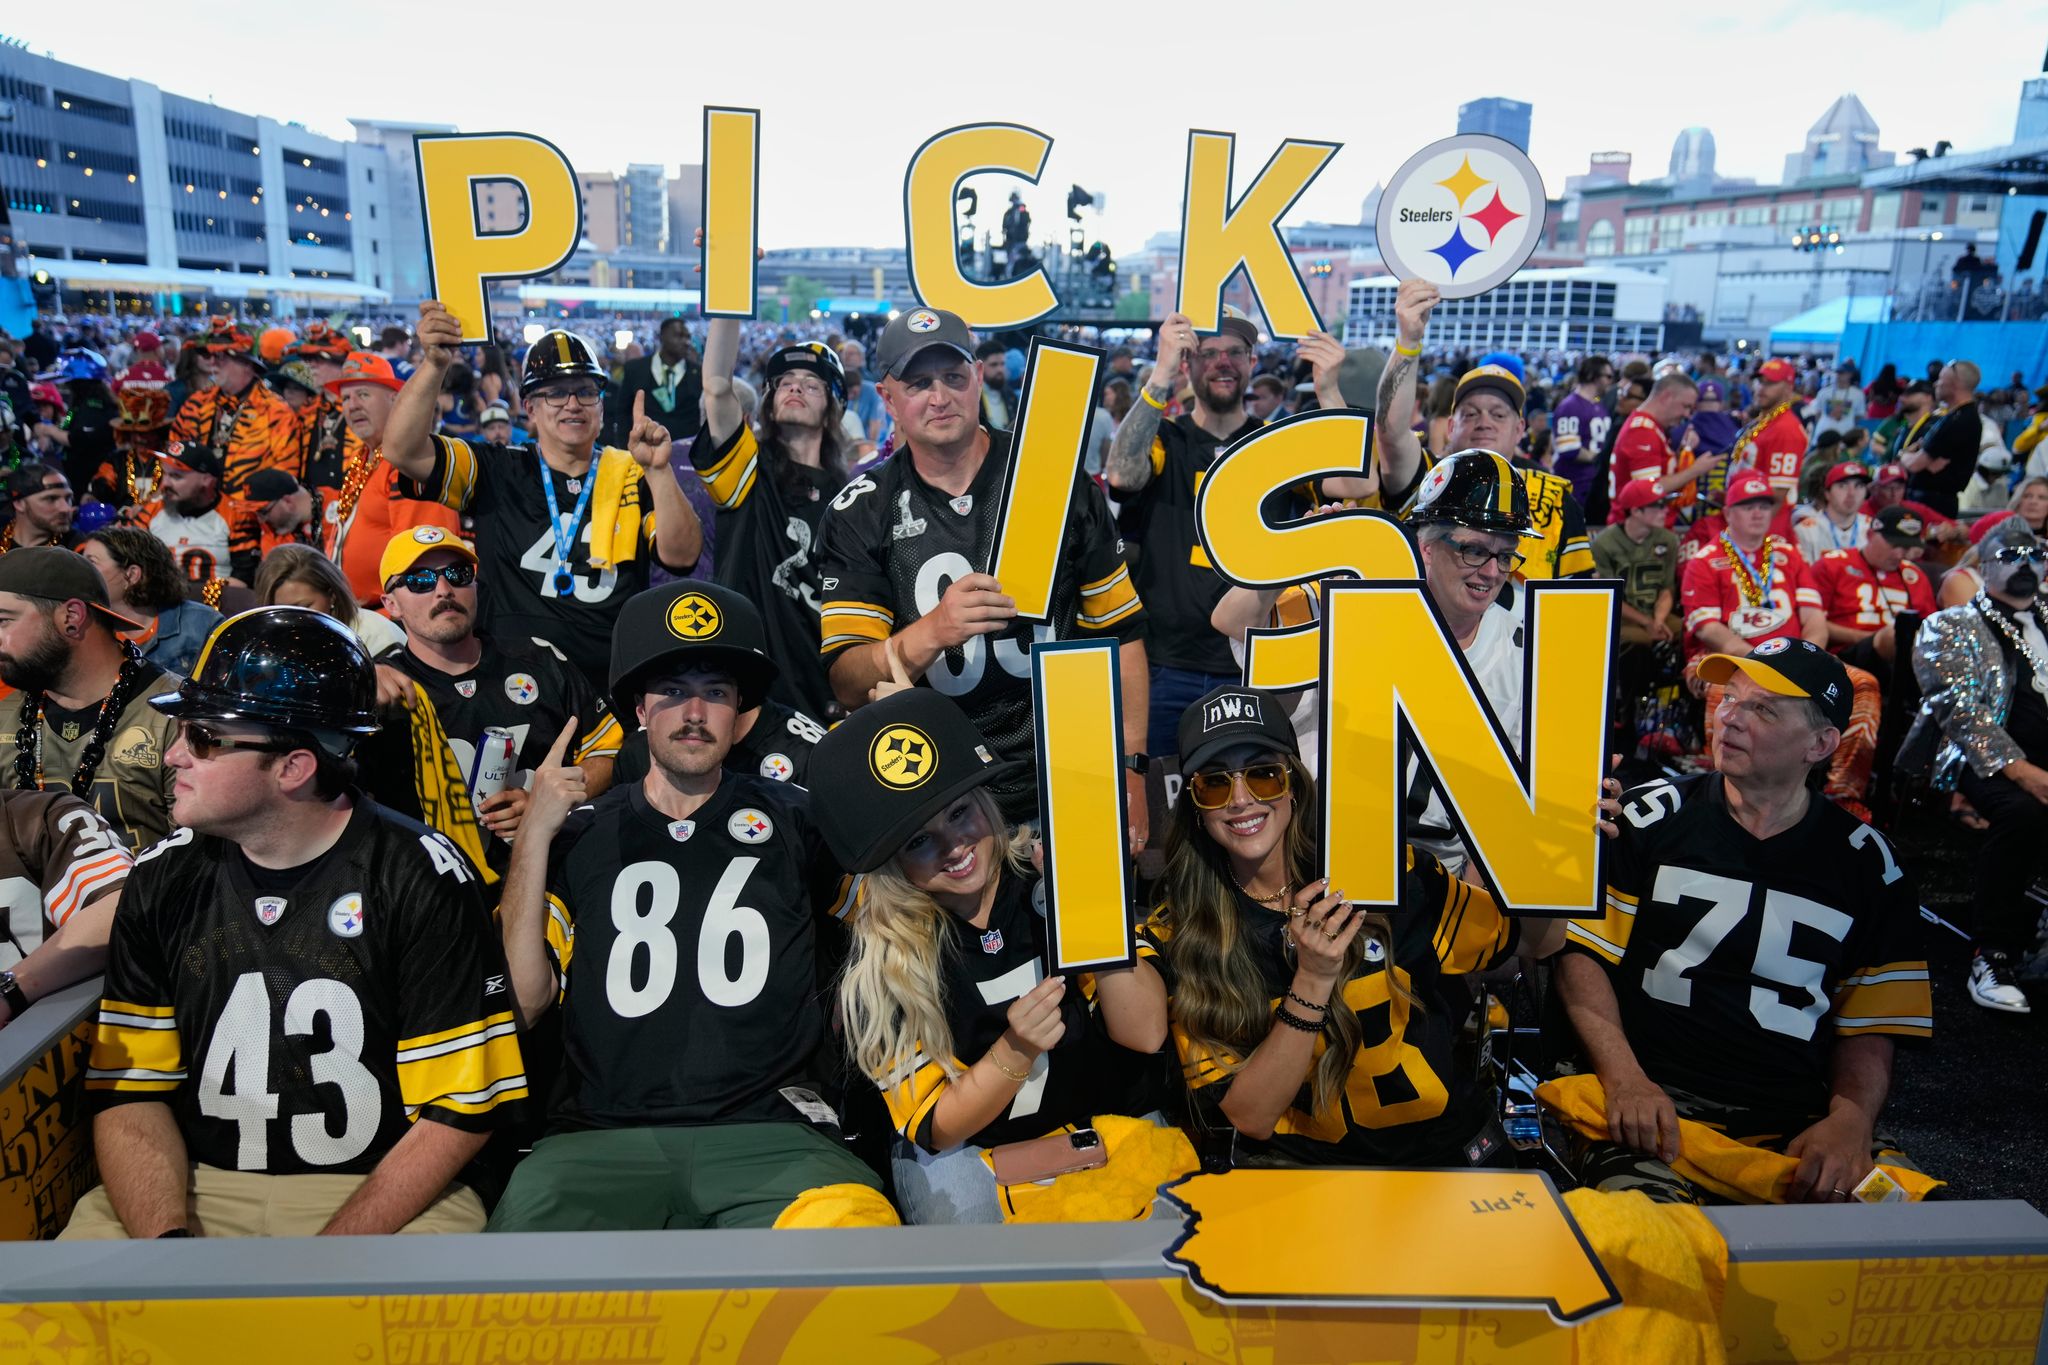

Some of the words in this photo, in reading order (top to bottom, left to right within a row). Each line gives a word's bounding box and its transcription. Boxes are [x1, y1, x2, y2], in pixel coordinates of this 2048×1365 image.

[1399, 207, 1453, 222] Steelers
[1557, 416, 1580, 435] 80
[1769, 452, 1798, 475] 58
[673, 614, 694, 622] Steelers
[1210, 697, 1255, 724] nWo
[63, 729, 79, 739] NFL
[880, 754, 904, 773] Steelers
[1848, 823, 1905, 886] 7
[606, 856, 772, 1018] 86
[985, 939, 1003, 952] NFL
[1641, 864, 1855, 1042] 75
[975, 956, 1050, 1121] 7
[199, 971, 382, 1171] 43
[1470, 1197, 1512, 1214] PIT
